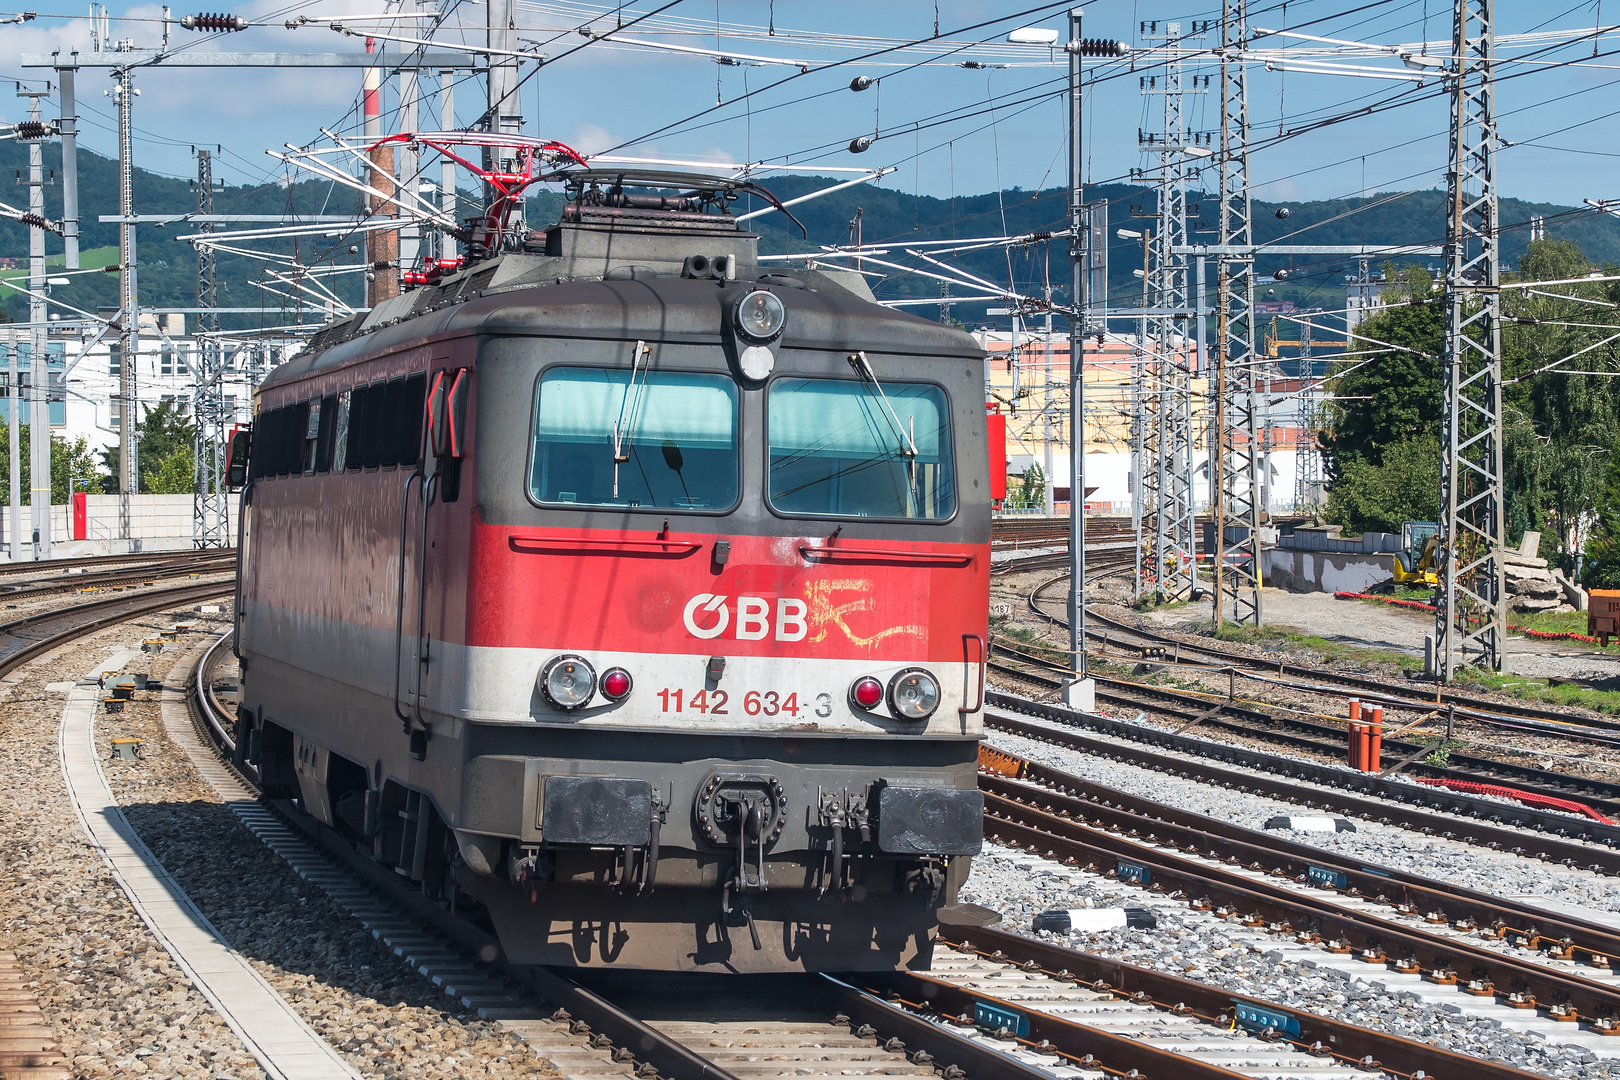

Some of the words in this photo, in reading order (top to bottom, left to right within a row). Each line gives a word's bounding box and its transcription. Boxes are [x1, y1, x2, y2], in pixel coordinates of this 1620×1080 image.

[683, 593, 808, 642] ÖBB
[994, 604, 1010, 613] 187
[656, 687, 729, 715] 1142
